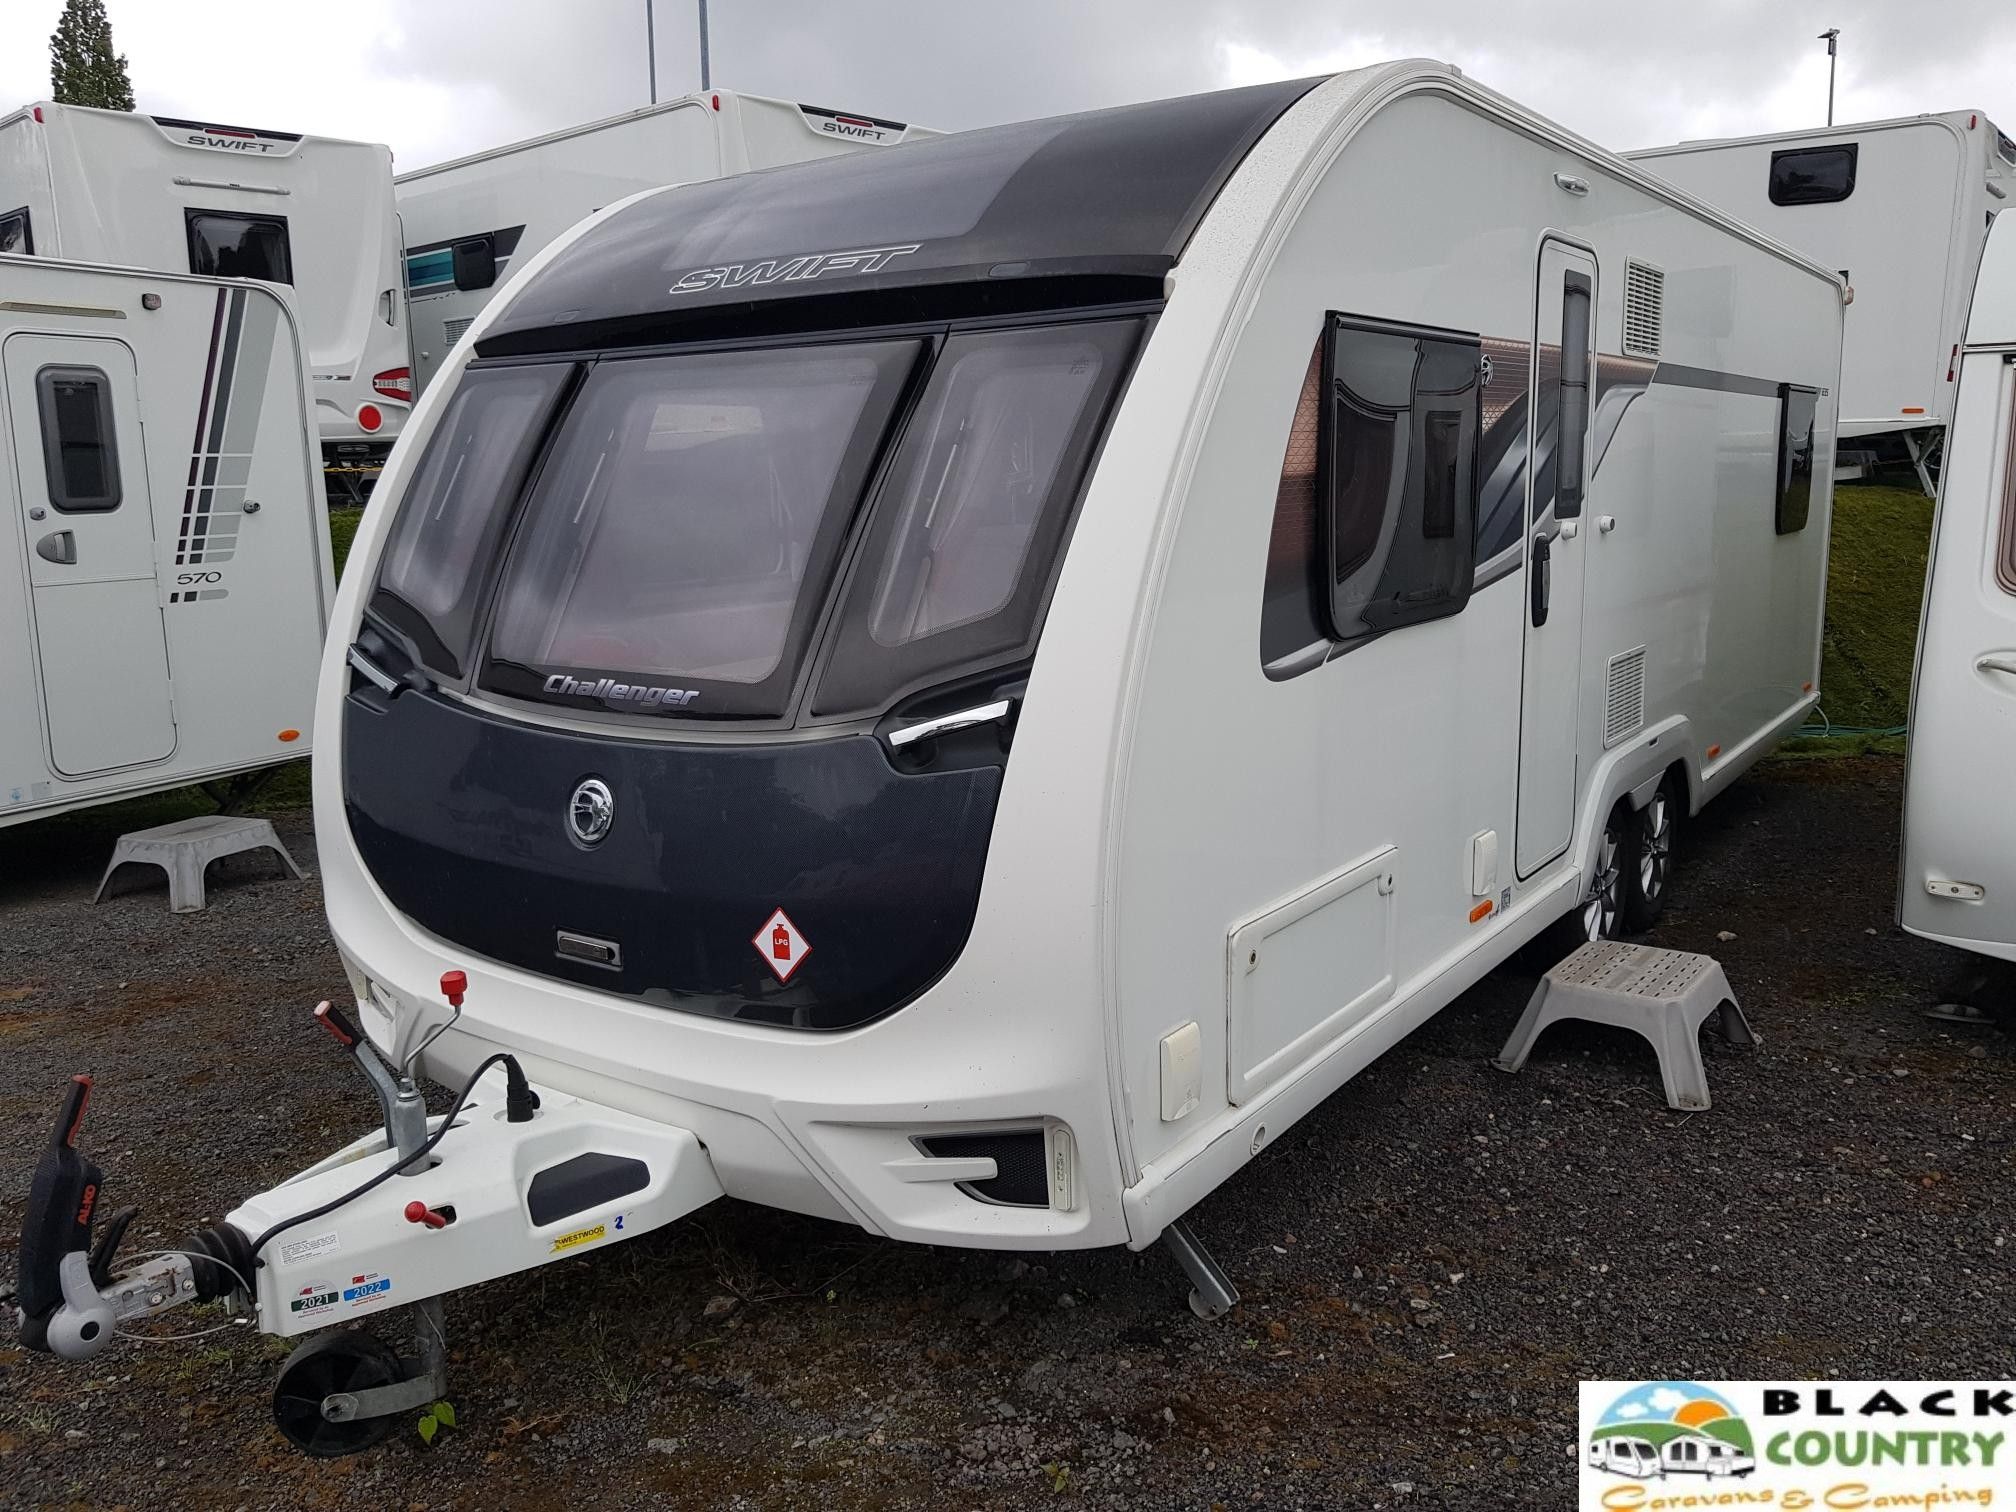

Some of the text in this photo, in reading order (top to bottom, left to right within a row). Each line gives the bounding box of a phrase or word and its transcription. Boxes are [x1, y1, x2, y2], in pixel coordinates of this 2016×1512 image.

[823, 122, 886, 140] SWIFT
[188, 136, 274, 152] SWIFT
[669, 243, 924, 294] SWIFT
[177, 571, 222, 585] 570
[543, 674, 700, 707] Challenger
[774, 938, 789, 946] LPG
[560, 1226, 605, 1244] WESTWOOD
[353, 1282, 382, 1298] 2022
[300, 1294, 329, 1309] 2021
